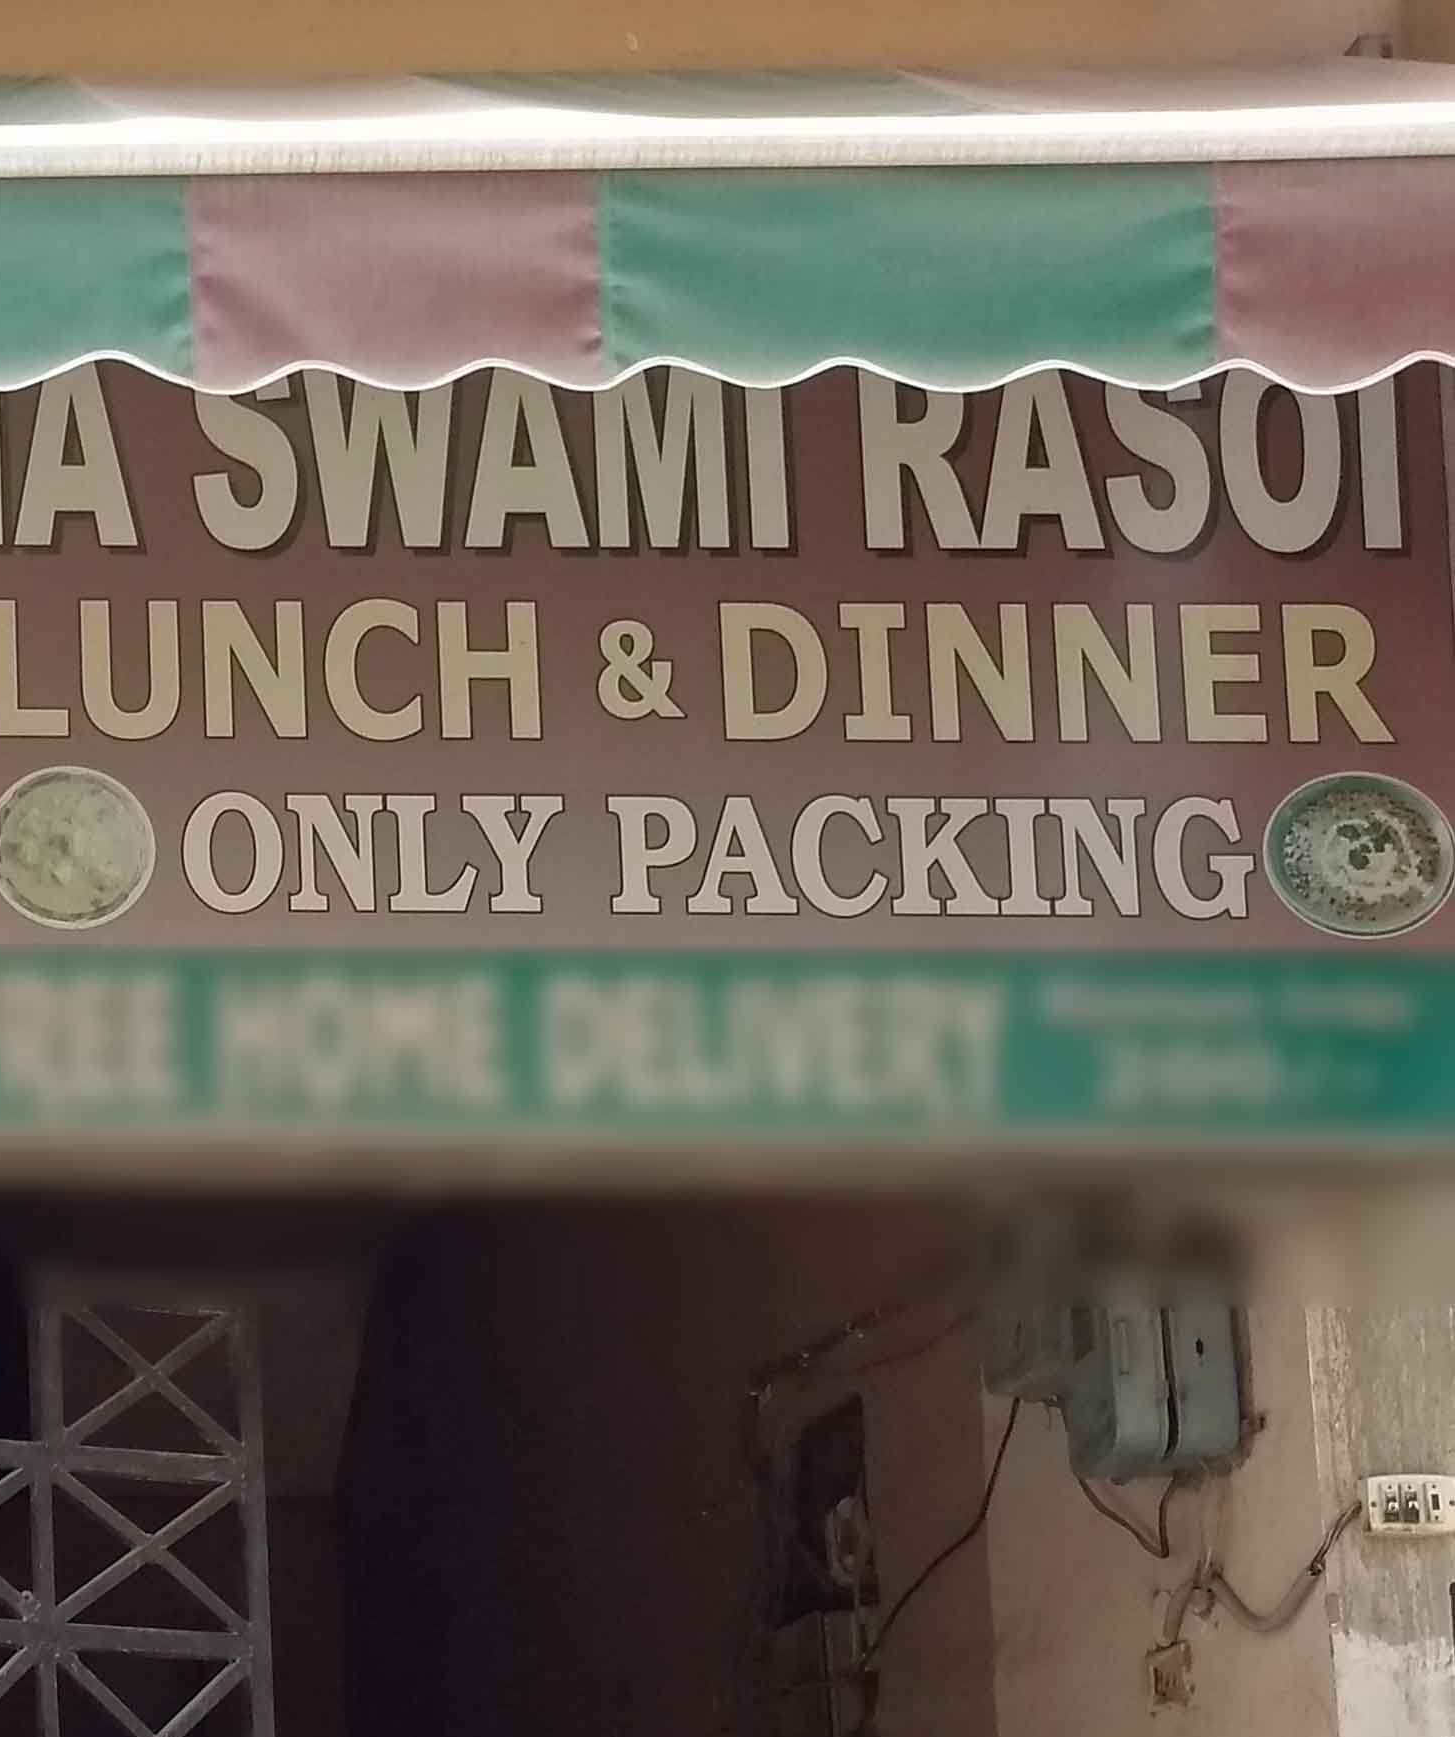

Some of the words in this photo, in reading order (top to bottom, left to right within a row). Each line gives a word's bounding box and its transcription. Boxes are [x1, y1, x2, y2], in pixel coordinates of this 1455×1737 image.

[192, 365, 790, 550] SWAMI
[857, 366, 1403, 553] RASOI
[596, 619, 687, 720] &
[717, 600, 1397, 744] DINNER
[180, 789, 566, 915] ONLY
[605, 793, 1256, 920] PACKING
